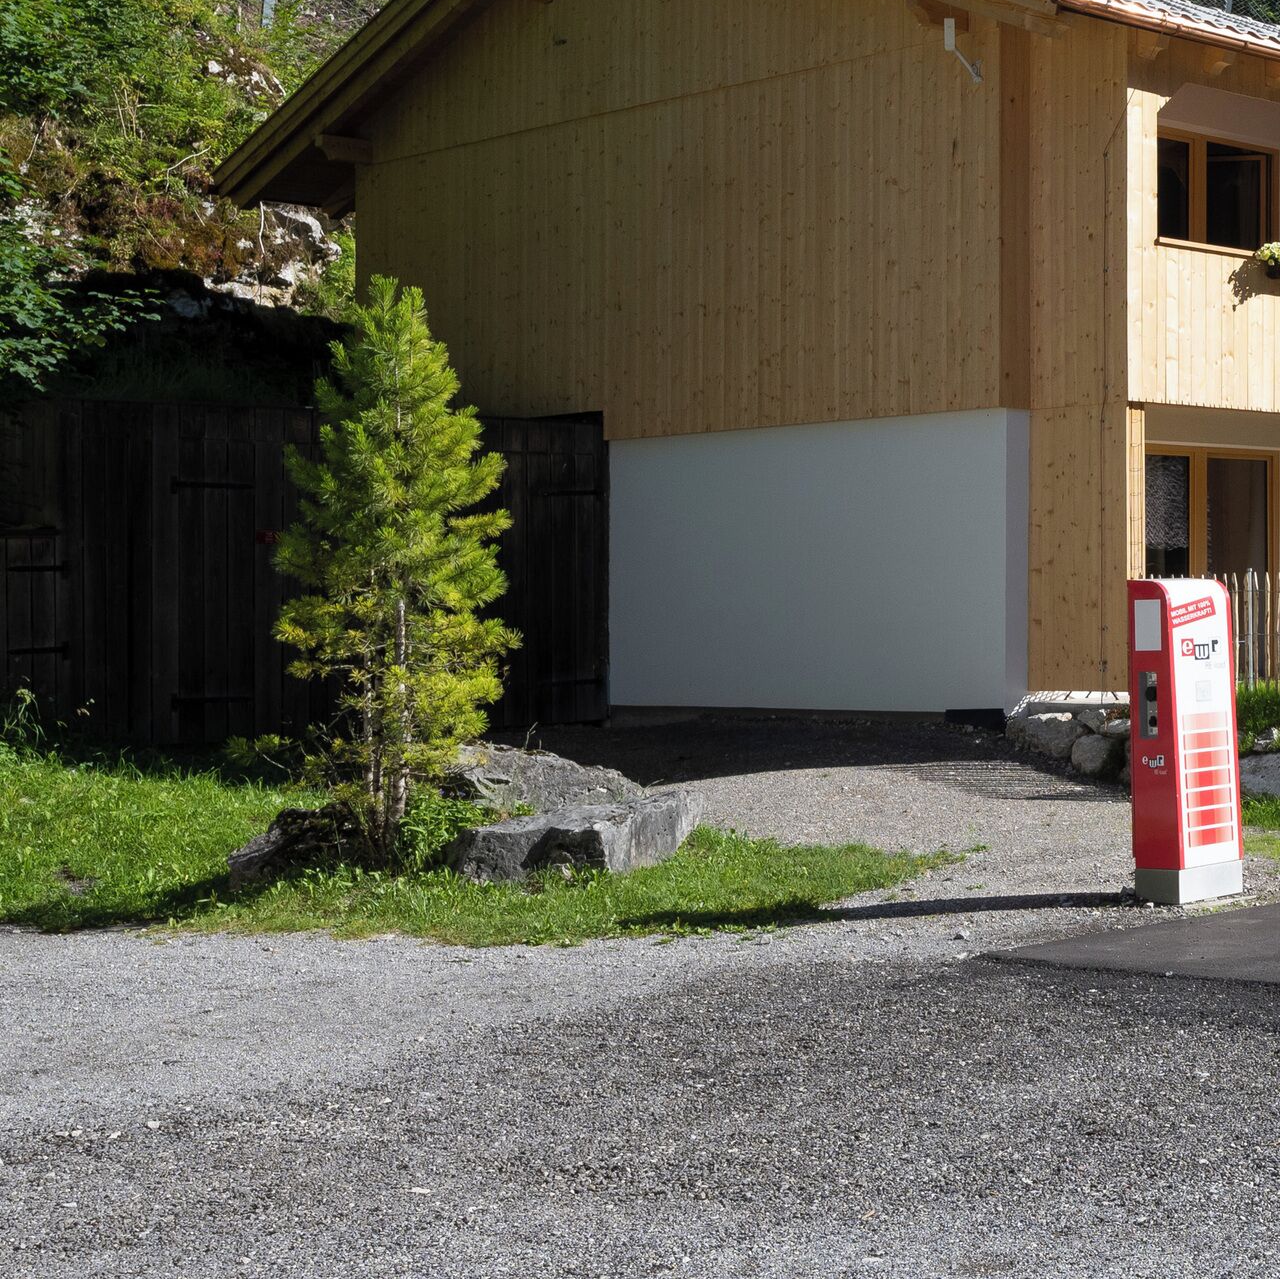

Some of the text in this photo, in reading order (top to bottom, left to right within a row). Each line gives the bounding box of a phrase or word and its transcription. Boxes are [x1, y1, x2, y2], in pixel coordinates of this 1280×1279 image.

[1187, 604, 1197, 613] MIT
[1181, 638, 1219, 660] ewr
[1142, 754, 1164, 768] ewr
